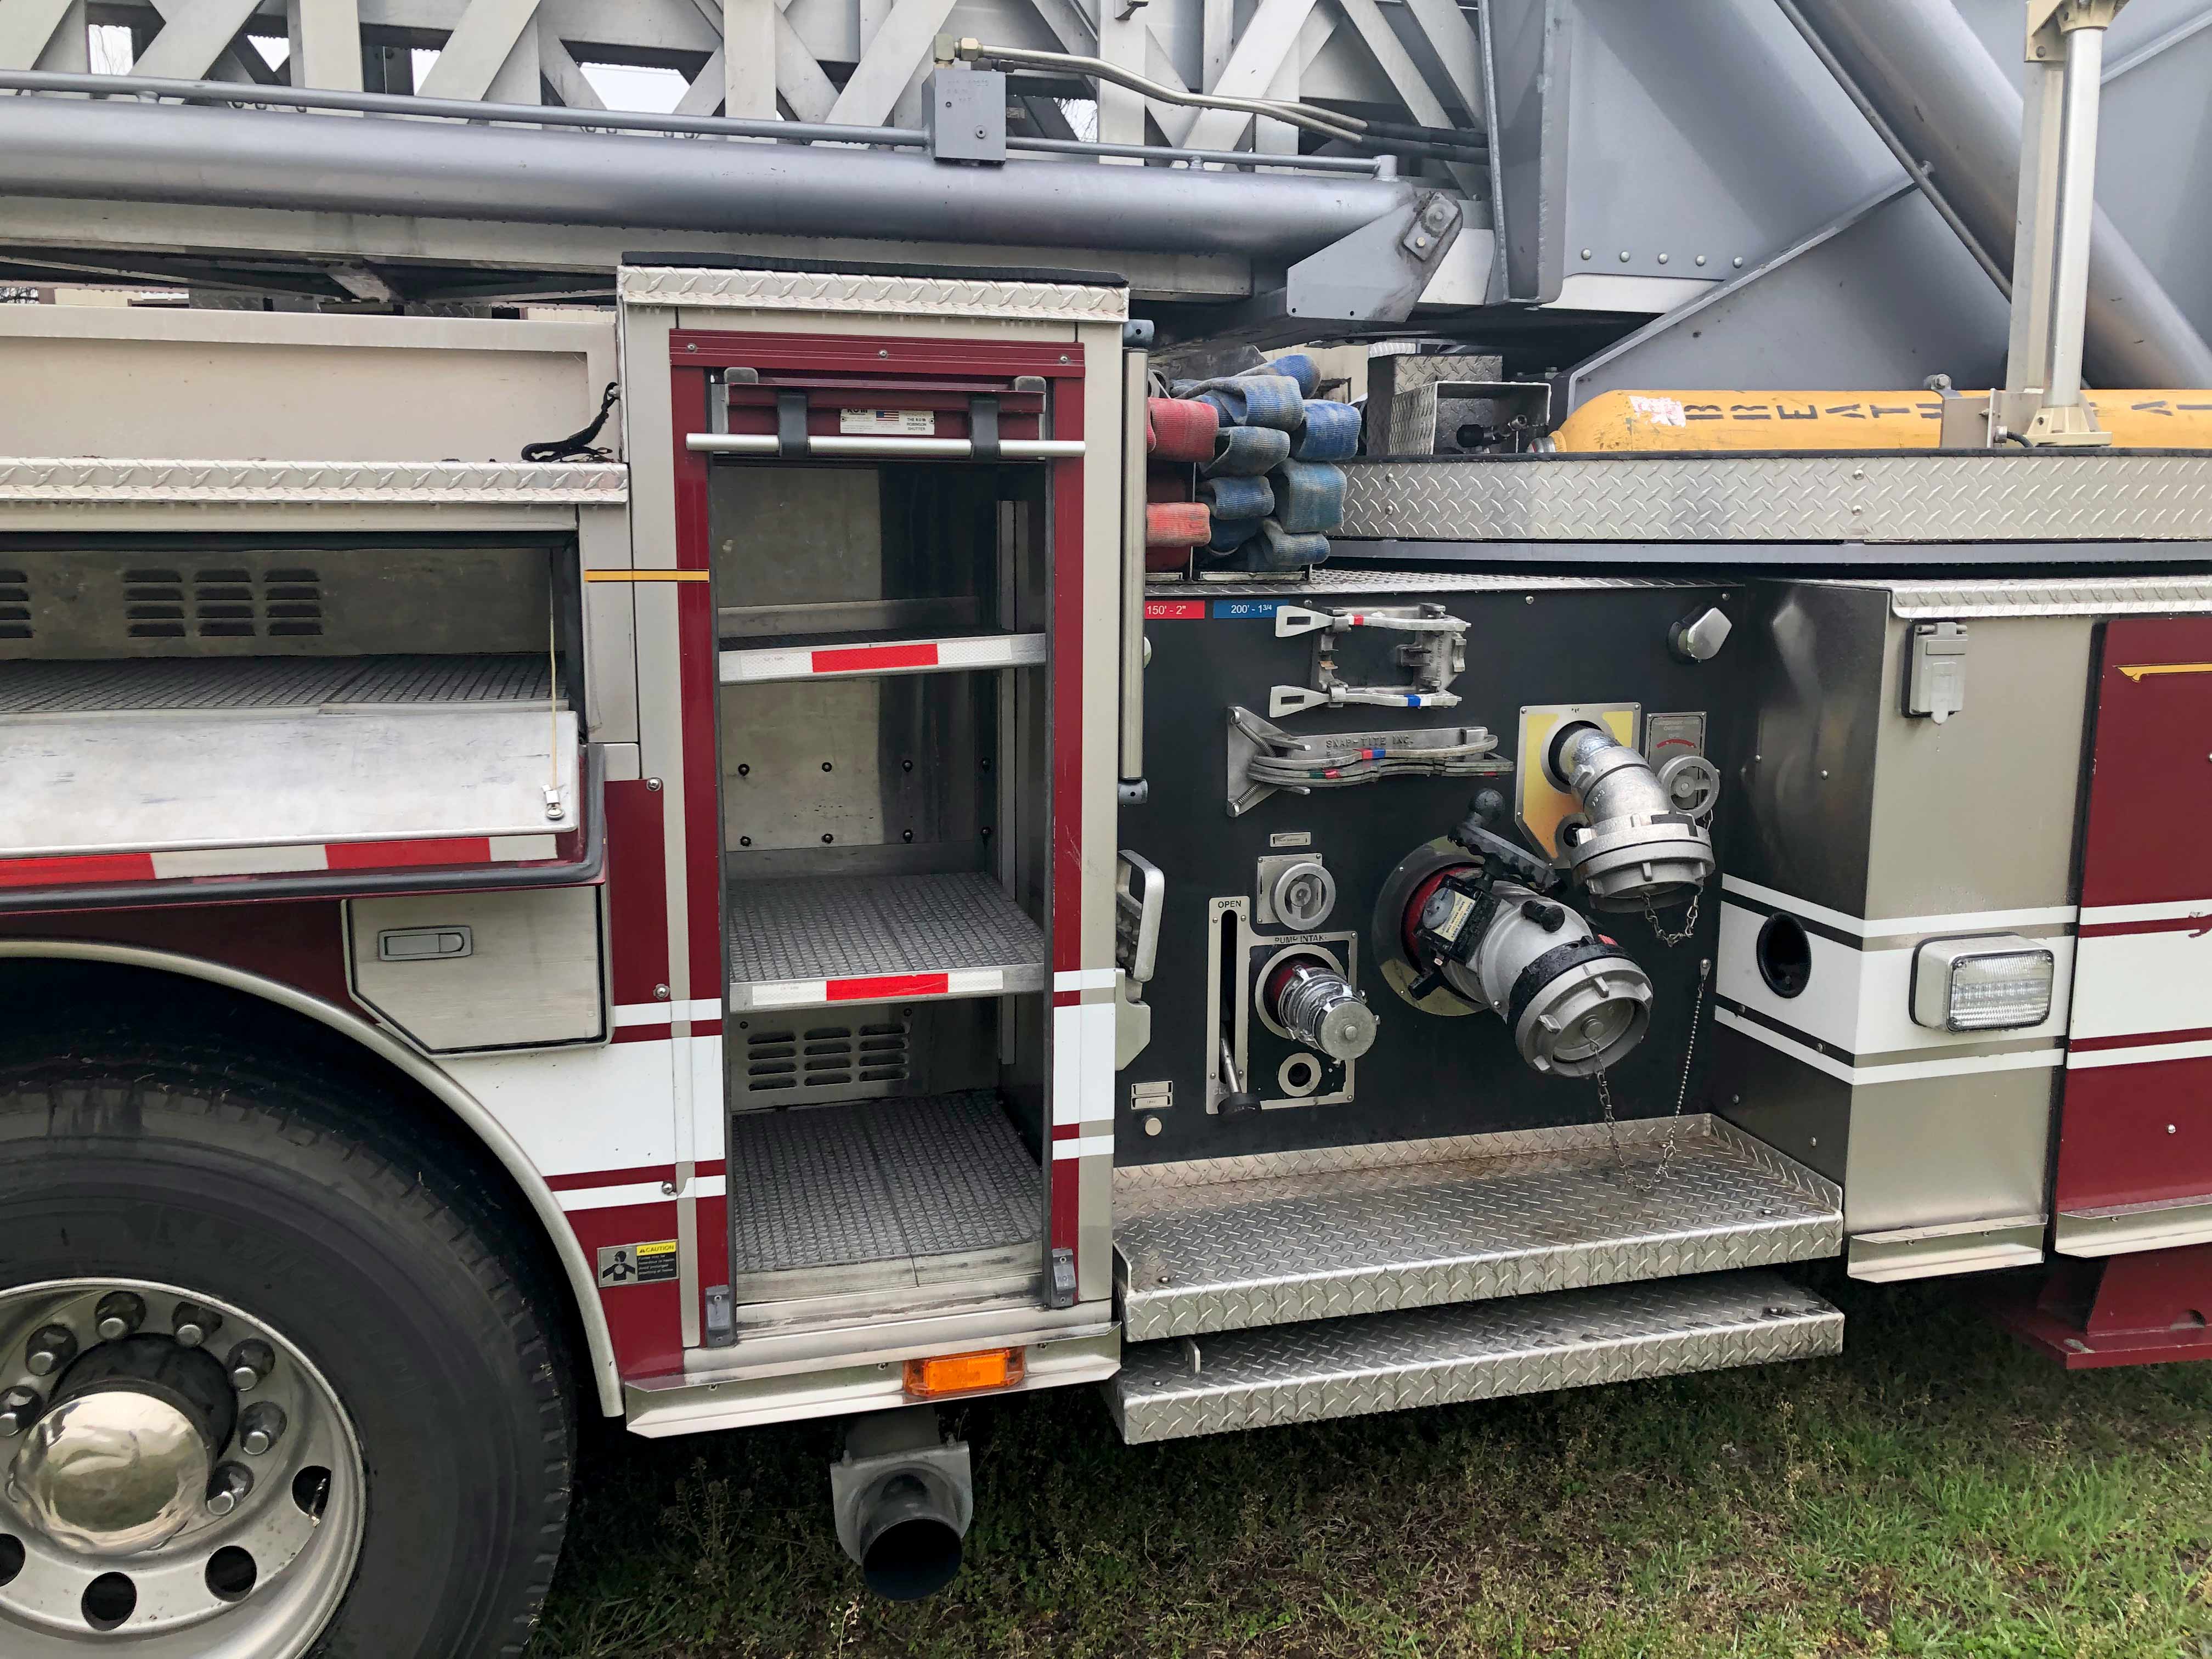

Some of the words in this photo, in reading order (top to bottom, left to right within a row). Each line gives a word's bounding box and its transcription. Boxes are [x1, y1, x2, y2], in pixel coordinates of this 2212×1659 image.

[1147, 605, 1167, 615] 150'
[1176, 605, 1186, 615] 2"
[1231, 605, 1250, 614] 200'
[1326, 736, 1386, 748] SNAP-TITE
[1217, 900, 1242, 909] OPEN
[1300, 934, 1328, 943] INTAK
